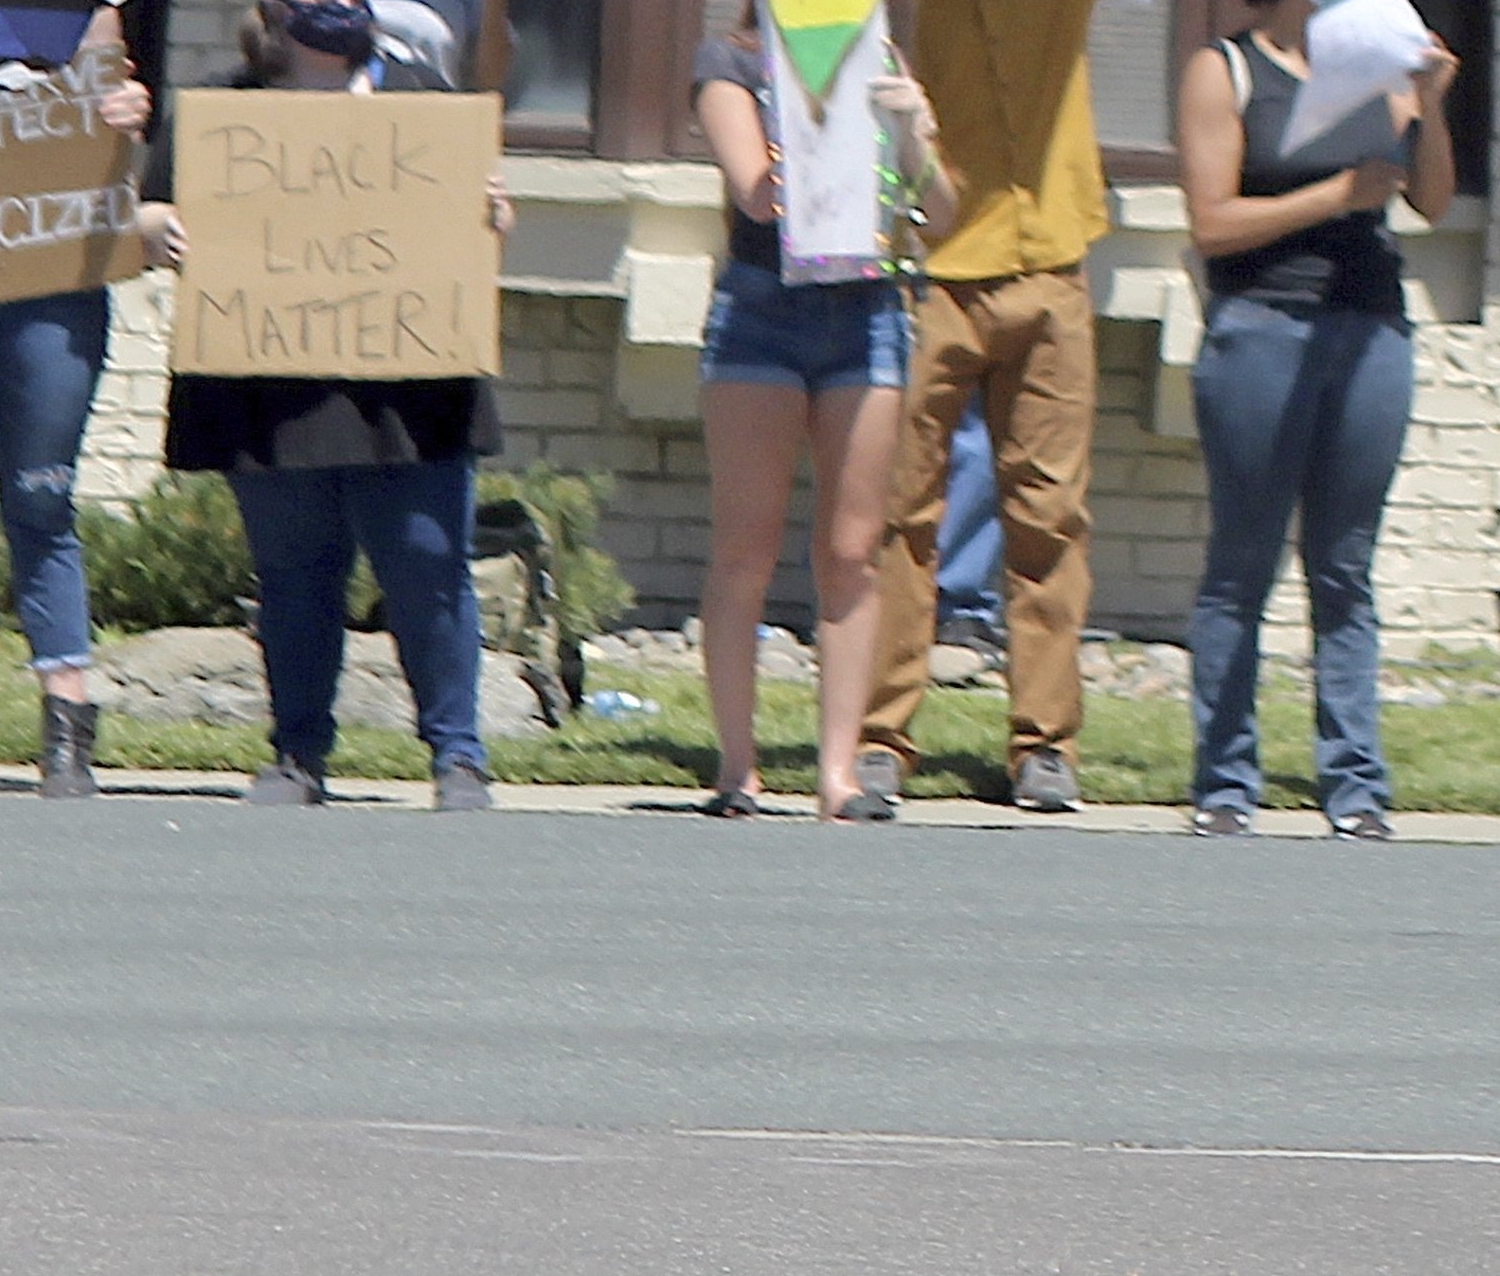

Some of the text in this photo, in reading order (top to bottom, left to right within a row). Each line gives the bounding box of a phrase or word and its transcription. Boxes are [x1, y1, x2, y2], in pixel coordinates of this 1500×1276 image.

[200, 122, 440, 201] BLACK
[263, 217, 398, 276] LIVES
[195, 279, 464, 365] MATTER!
